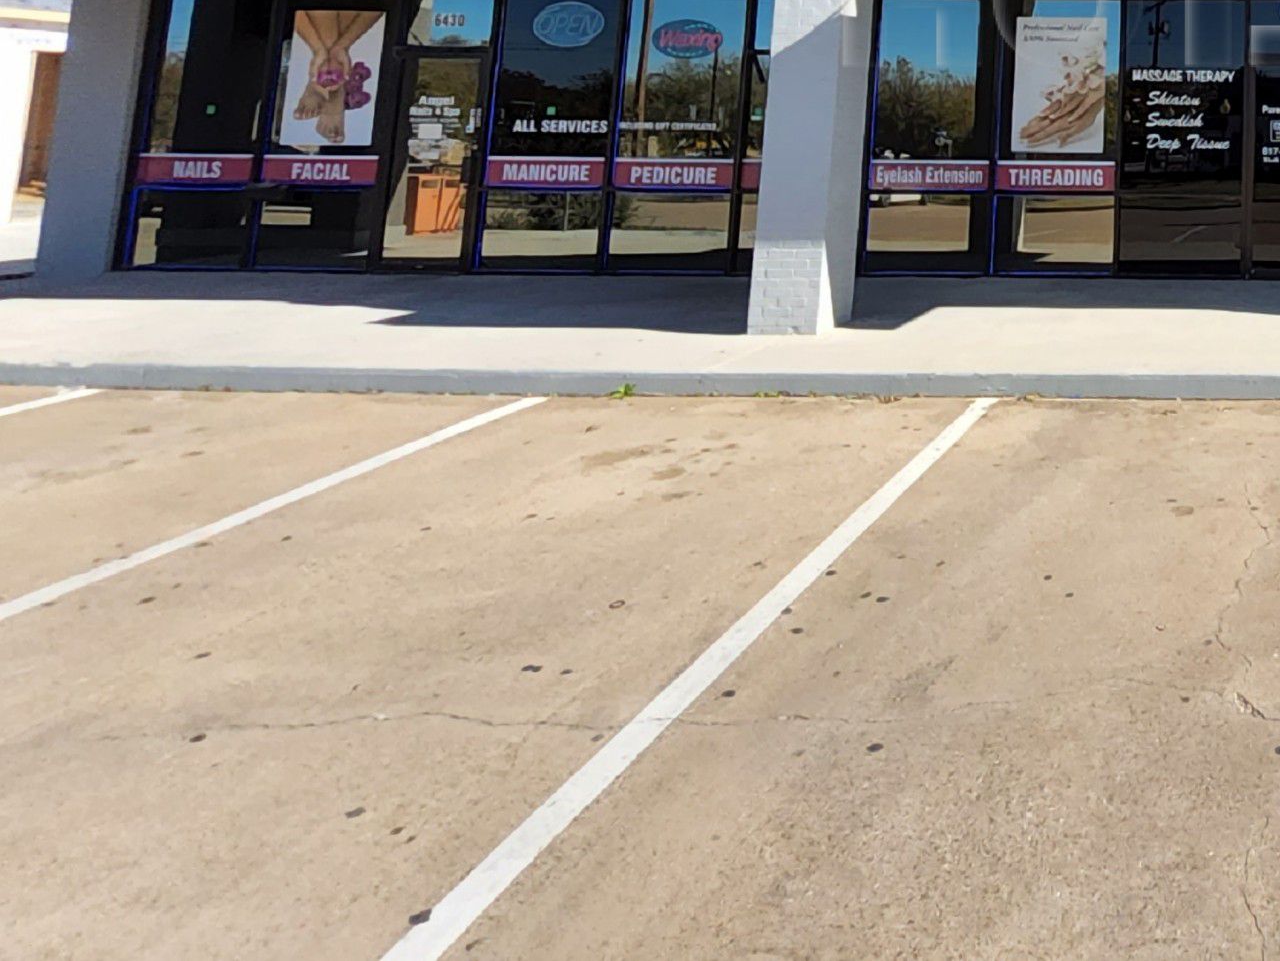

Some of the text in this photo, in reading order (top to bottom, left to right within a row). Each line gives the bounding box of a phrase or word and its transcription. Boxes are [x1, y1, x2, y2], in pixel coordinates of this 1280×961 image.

[434, 13, 465, 27] 6430
[538, 13, 599, 36] OPEN
[659, 29, 722, 50] Waxing
[1132, 69, 1235, 82] MASSAGE THERAPY
[1146, 90, 1201, 106] Shiatsu
[512, 119, 537, 133] ALL
[541, 120, 608, 133] SERVICES
[1145, 111, 1204, 127] Swedish
[1146, 133, 1230, 153] Deep Tissue
[173, 161, 222, 179] NAILS
[291, 162, 350, 181] FACIAL
[502, 164, 590, 182] MANICURE
[631, 166, 717, 184] PEDICURE
[876, 165, 983, 186] Eyelash Extension
[1008, 168, 1103, 186] THREADING
